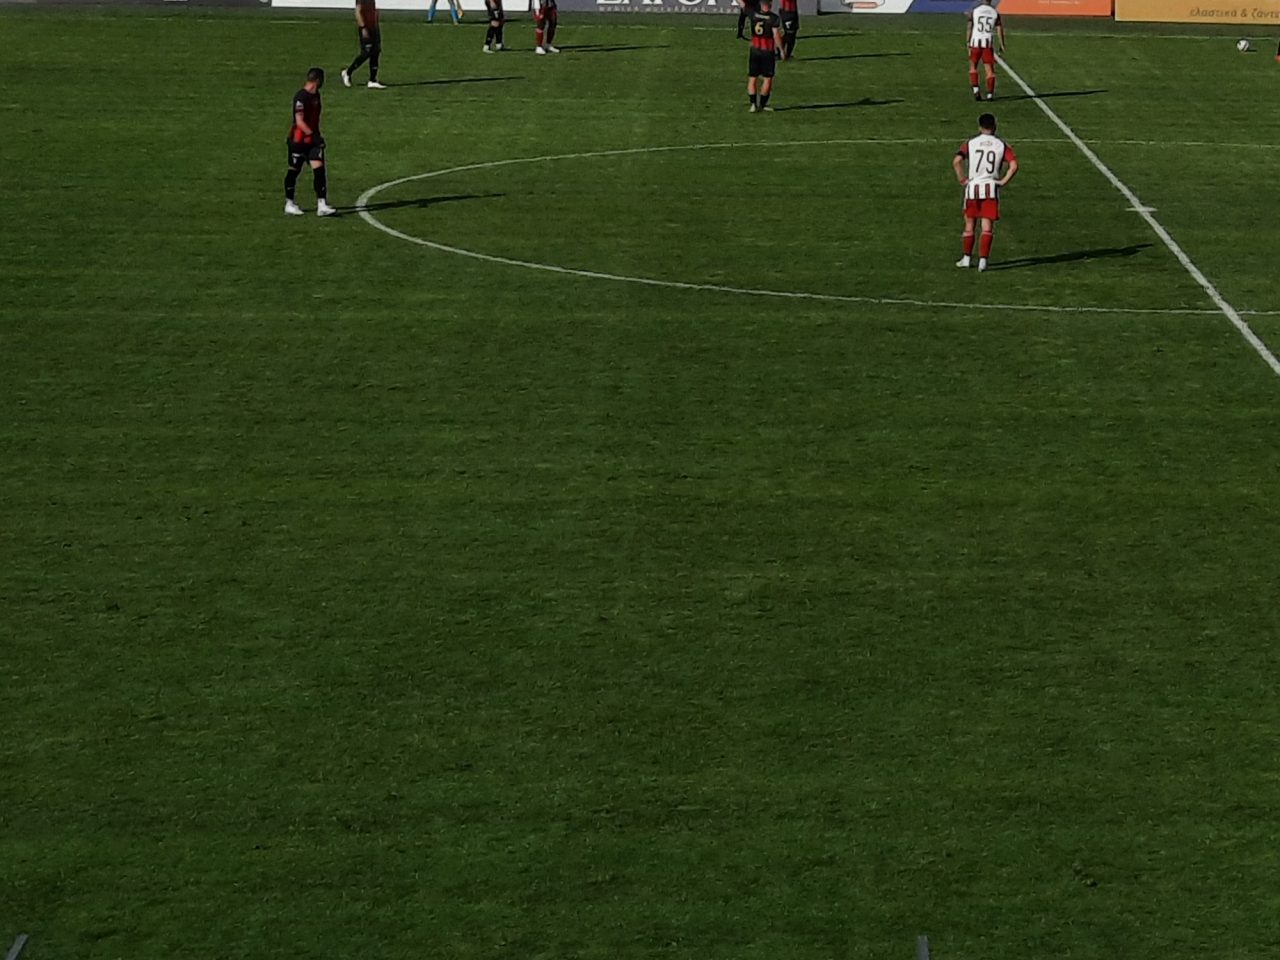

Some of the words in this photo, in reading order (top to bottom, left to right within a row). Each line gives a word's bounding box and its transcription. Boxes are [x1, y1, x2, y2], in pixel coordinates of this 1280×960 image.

[754, 21, 764, 35] 6
[977, 15, 993, 33] 55
[975, 149, 997, 174] 79
